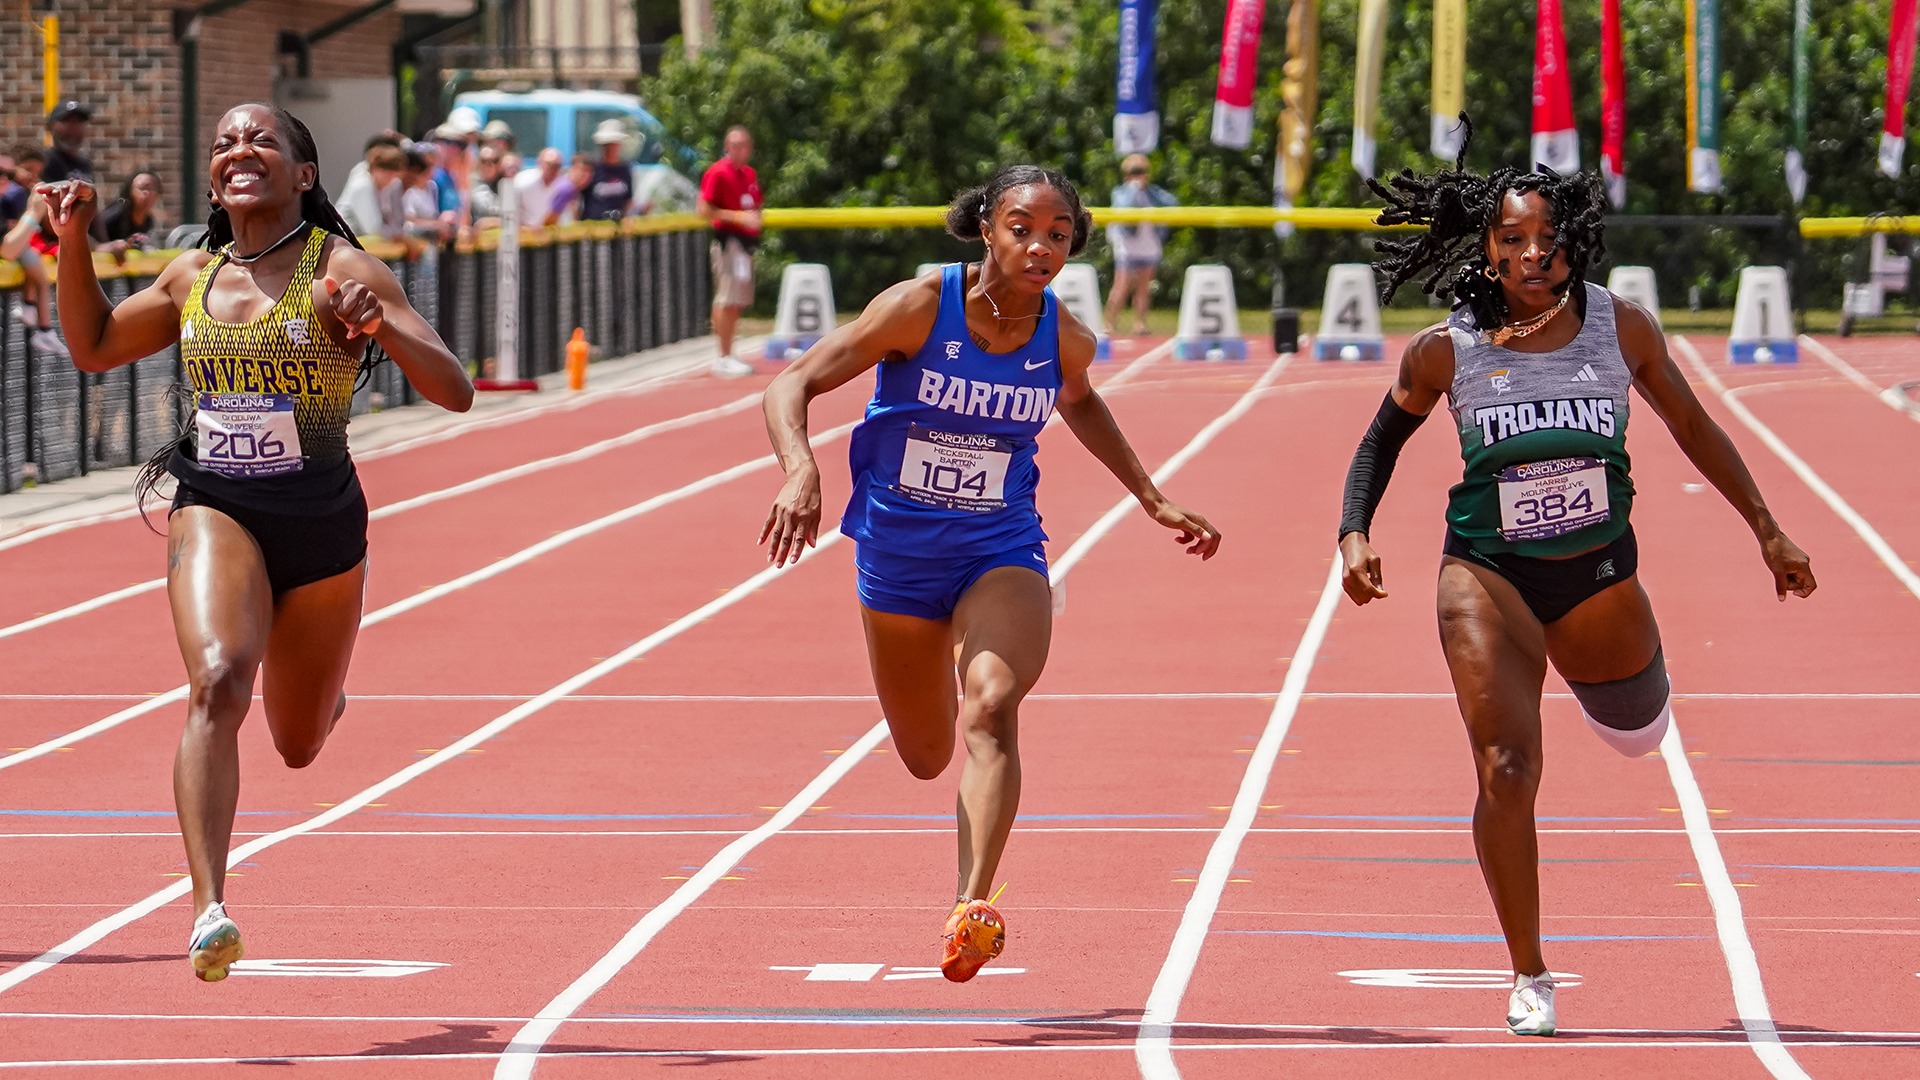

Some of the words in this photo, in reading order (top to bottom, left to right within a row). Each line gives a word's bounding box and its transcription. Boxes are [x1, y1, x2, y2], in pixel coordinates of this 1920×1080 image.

[795, 293, 822, 332] 8
[1198, 295, 1224, 334] 5
[1336, 295, 1362, 333] 4
[182, 357, 324, 396] ONVERSE
[211, 398, 274, 408] CAROLINAS
[918, 368, 1056, 422] BARTON
[929, 430, 996, 447] CAROLINAS
[1475, 398, 1616, 448] TROJANS
[208, 430, 285, 460] 206
[933, 446, 984, 460] HECKSTALL
[940, 456, 976, 467] BARTON
[921, 460, 987, 497] 104
[1517, 460, 1586, 478] CAROLINAS
[1535, 476, 1569, 488] HARRIS
[1521, 487, 1552, 498] MOUNT
[1557, 481, 1585, 491] OLIVE
[1514, 488, 1594, 526] 384
